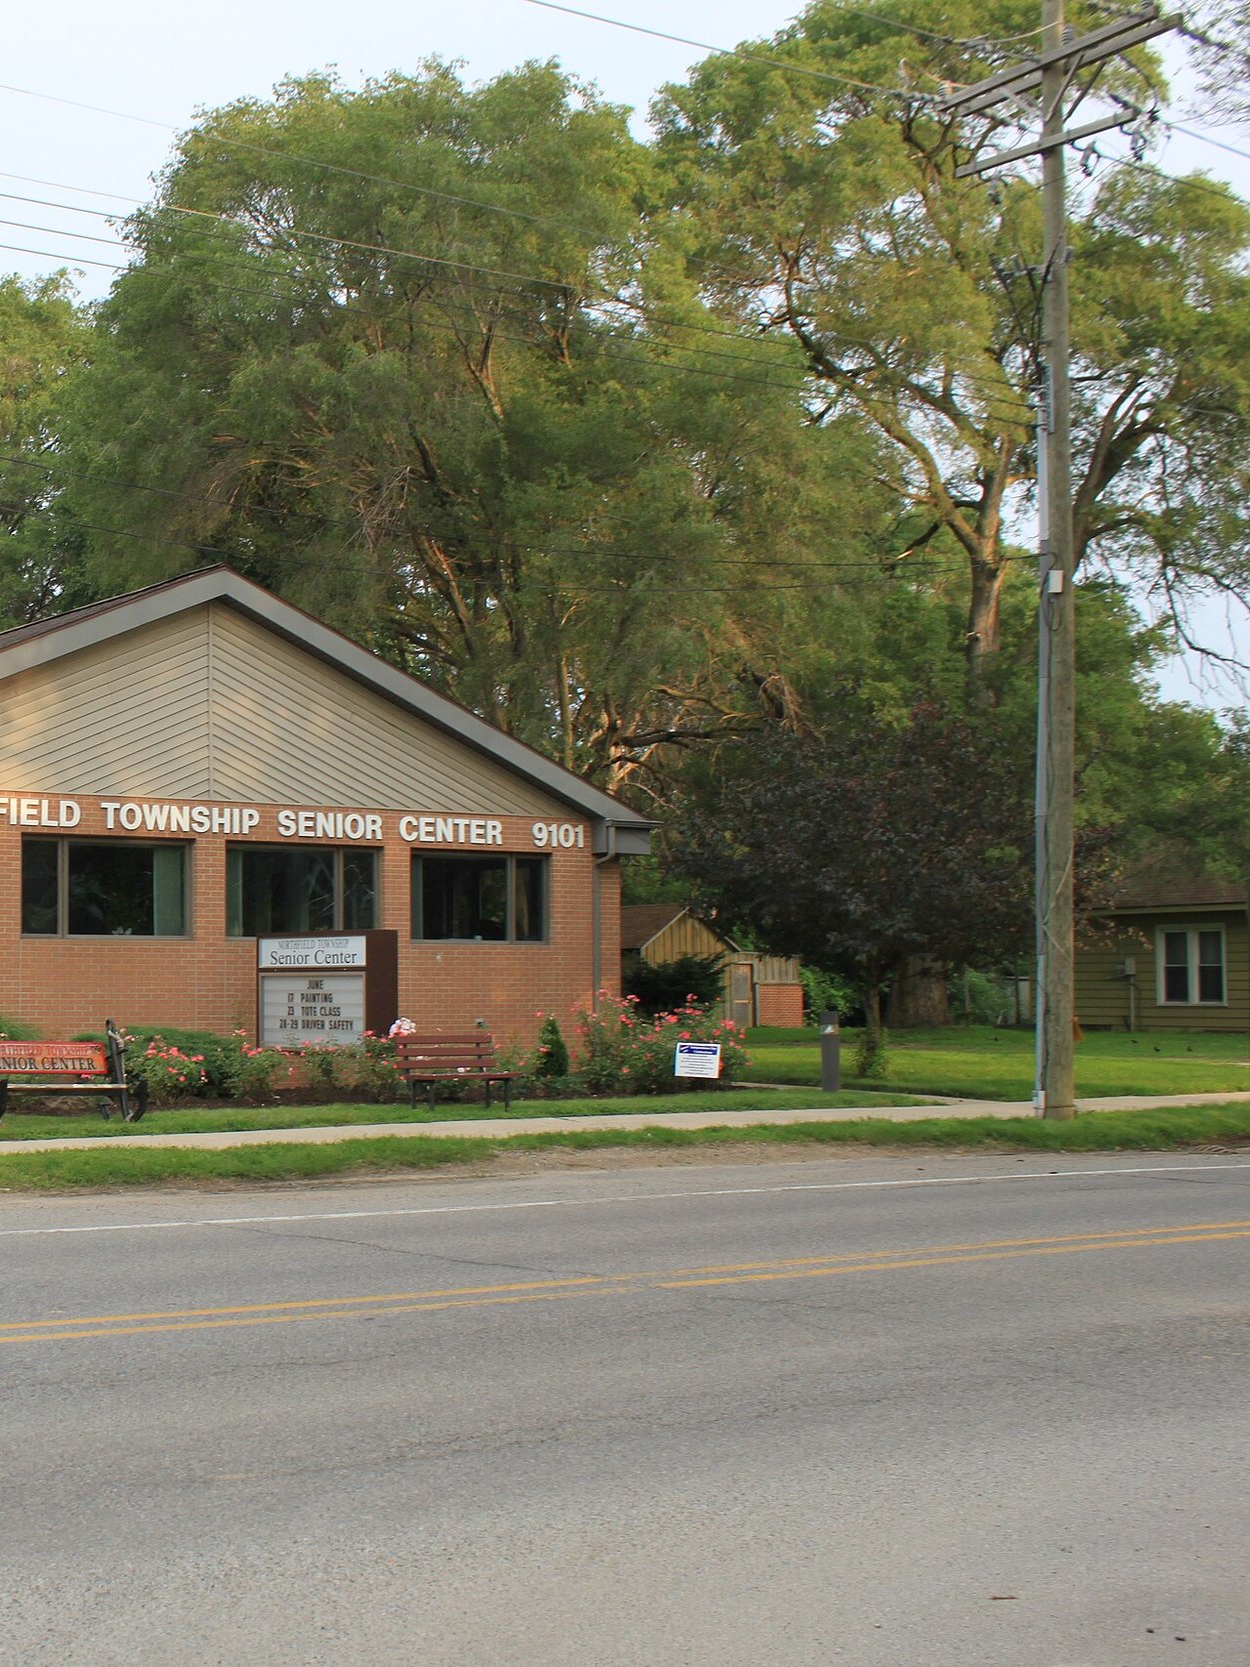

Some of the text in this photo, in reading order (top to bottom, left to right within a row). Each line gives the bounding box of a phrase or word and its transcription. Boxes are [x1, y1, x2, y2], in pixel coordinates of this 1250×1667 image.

[101, 802, 260, 834] TOWNSHIP
[277, 809, 383, 840] SENIOR
[399, 815, 503, 845] CENTER
[532, 822, 584, 848] 9101
[270, 949, 357, 965] Senior Center
[307, 979, 324, 990] JUNE
[300, 993, 333, 1003] PAINTING
[287, 1006, 341, 1017] 23 TOTE CLASS
[301, 1019, 325, 1030] DRIVER
[328, 1020, 354, 1031] SAFETY
[41, 1056, 96, 1070] CENTER
